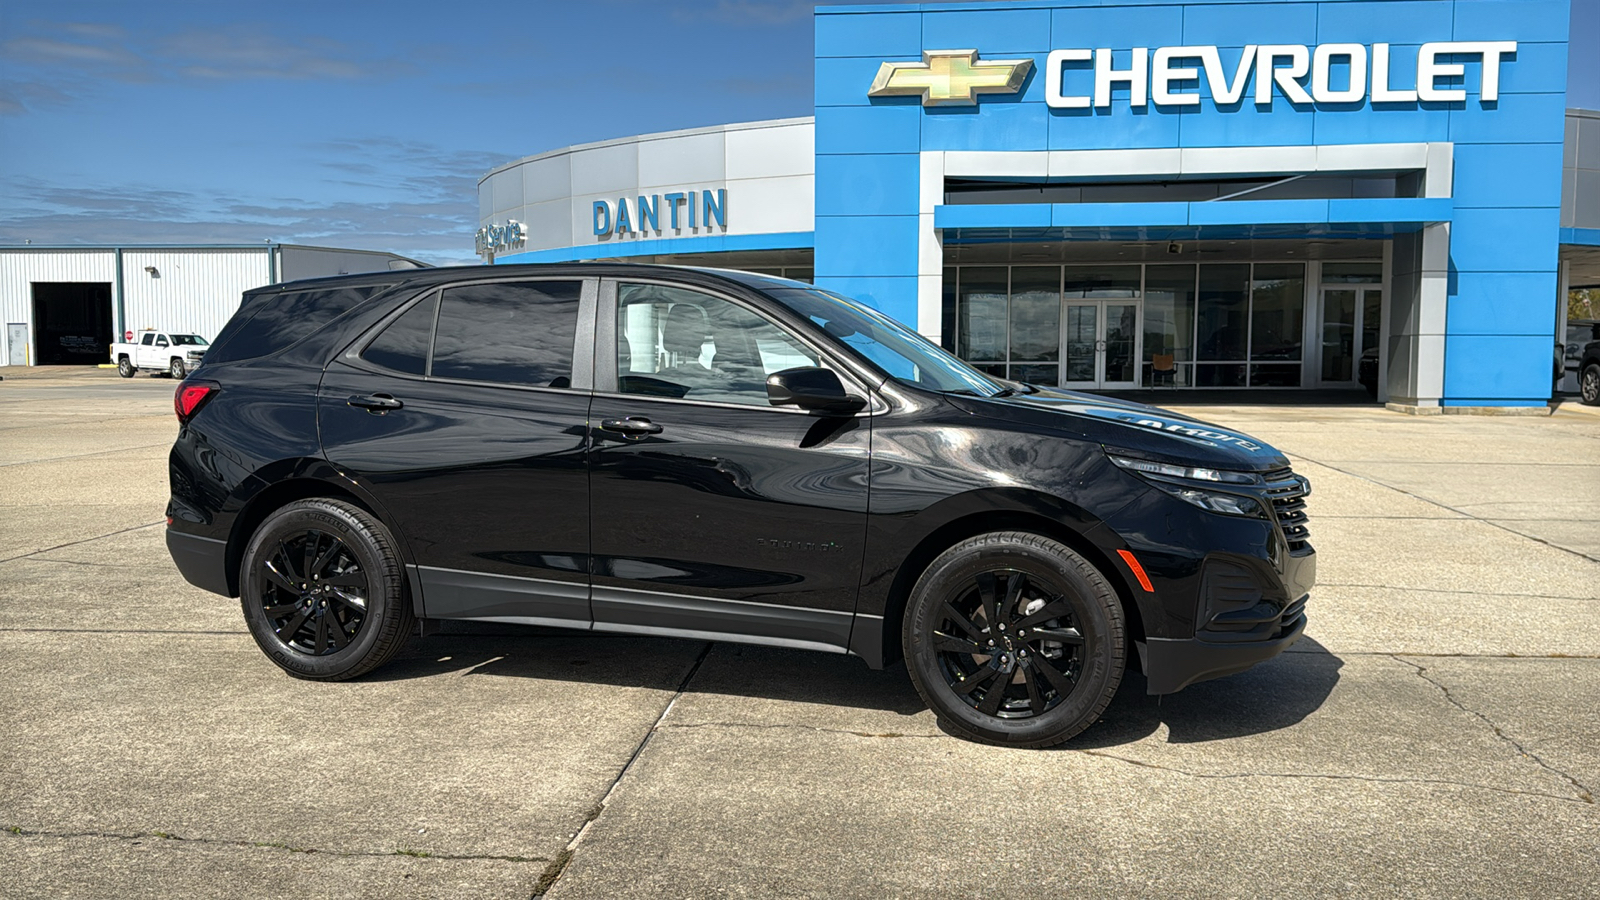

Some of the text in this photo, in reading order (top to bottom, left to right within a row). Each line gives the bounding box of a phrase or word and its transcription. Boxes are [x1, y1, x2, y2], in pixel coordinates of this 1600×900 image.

[1045, 41, 1517, 108] CHEVROLET
[487, 219, 522, 249] Service
[593, 188, 726, 236] DANTIN
